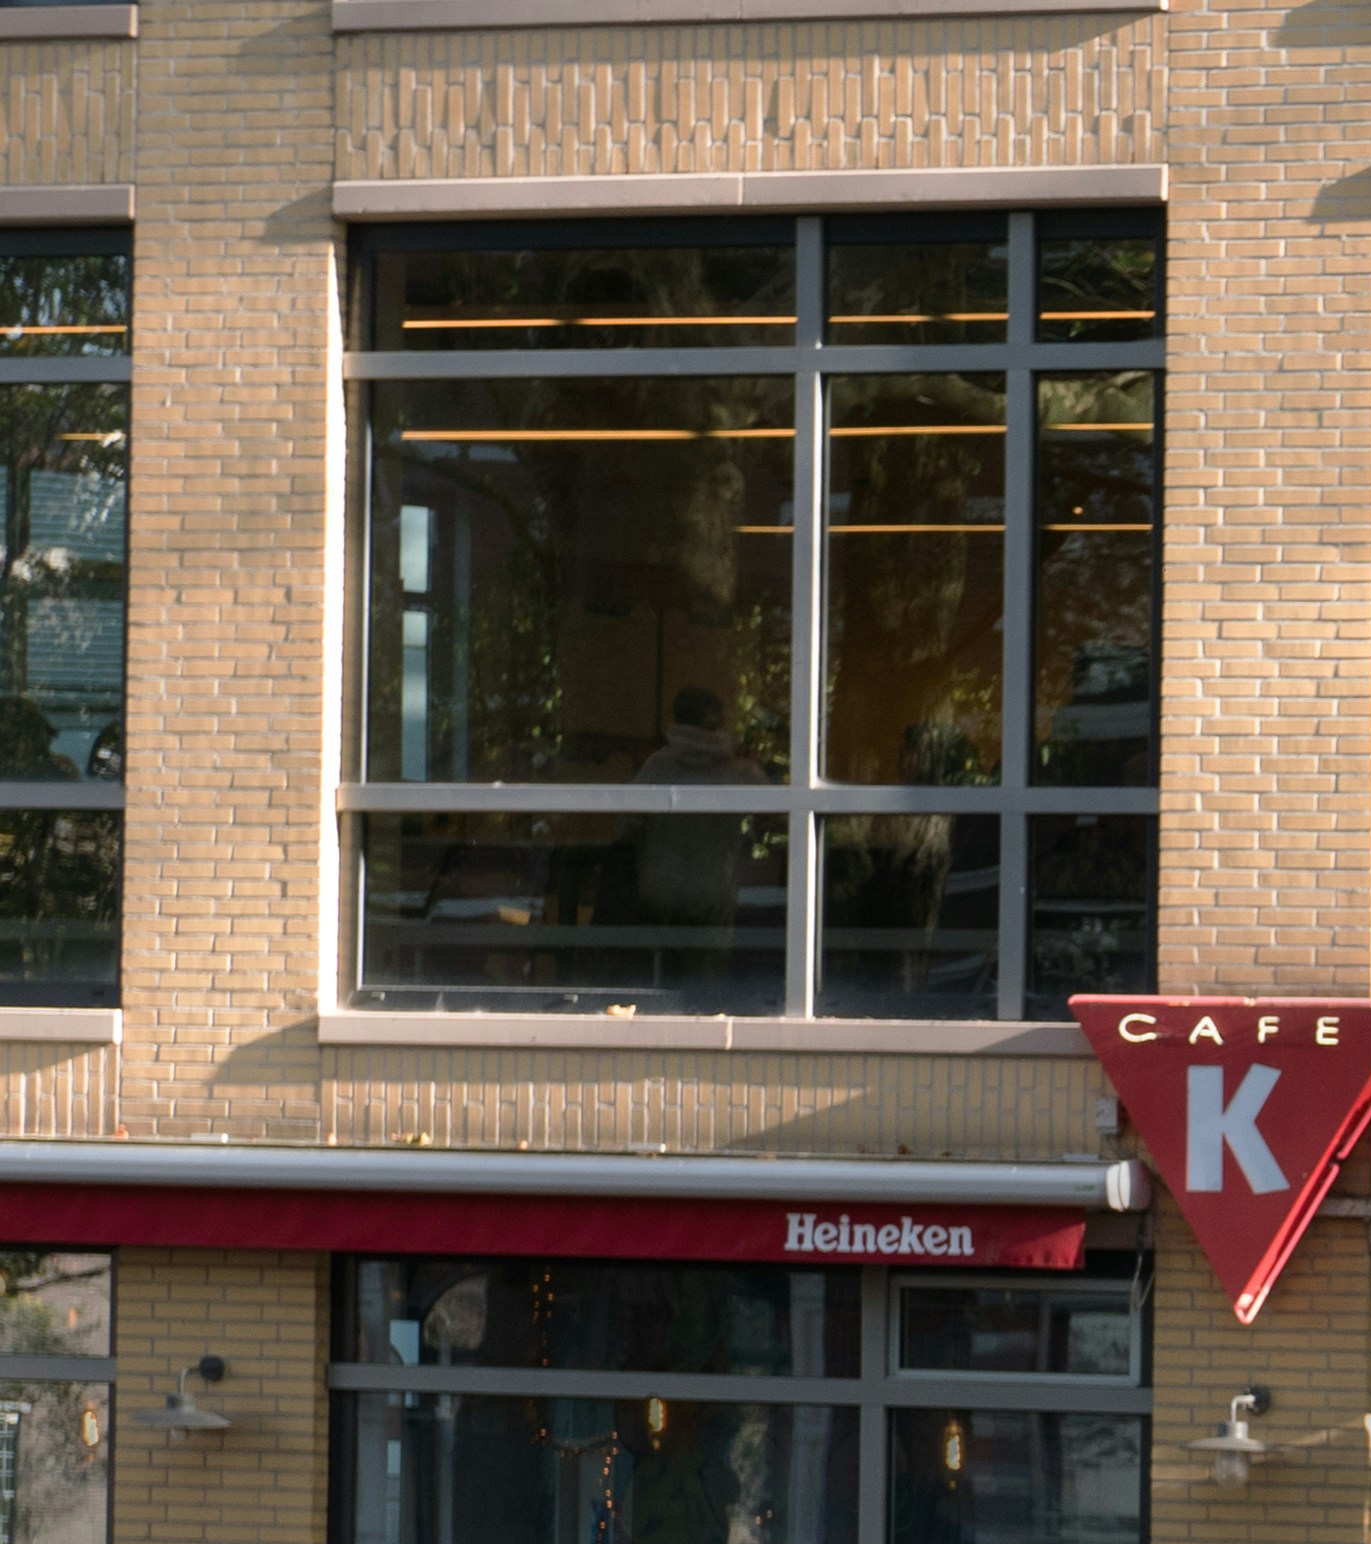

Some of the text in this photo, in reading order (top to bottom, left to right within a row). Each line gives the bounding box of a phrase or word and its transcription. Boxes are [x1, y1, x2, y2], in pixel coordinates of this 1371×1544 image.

[1116, 1011, 1341, 1046] CAFE
[1186, 1062, 1291, 1196] K
[784, 1211, 975, 1256] Heineken
